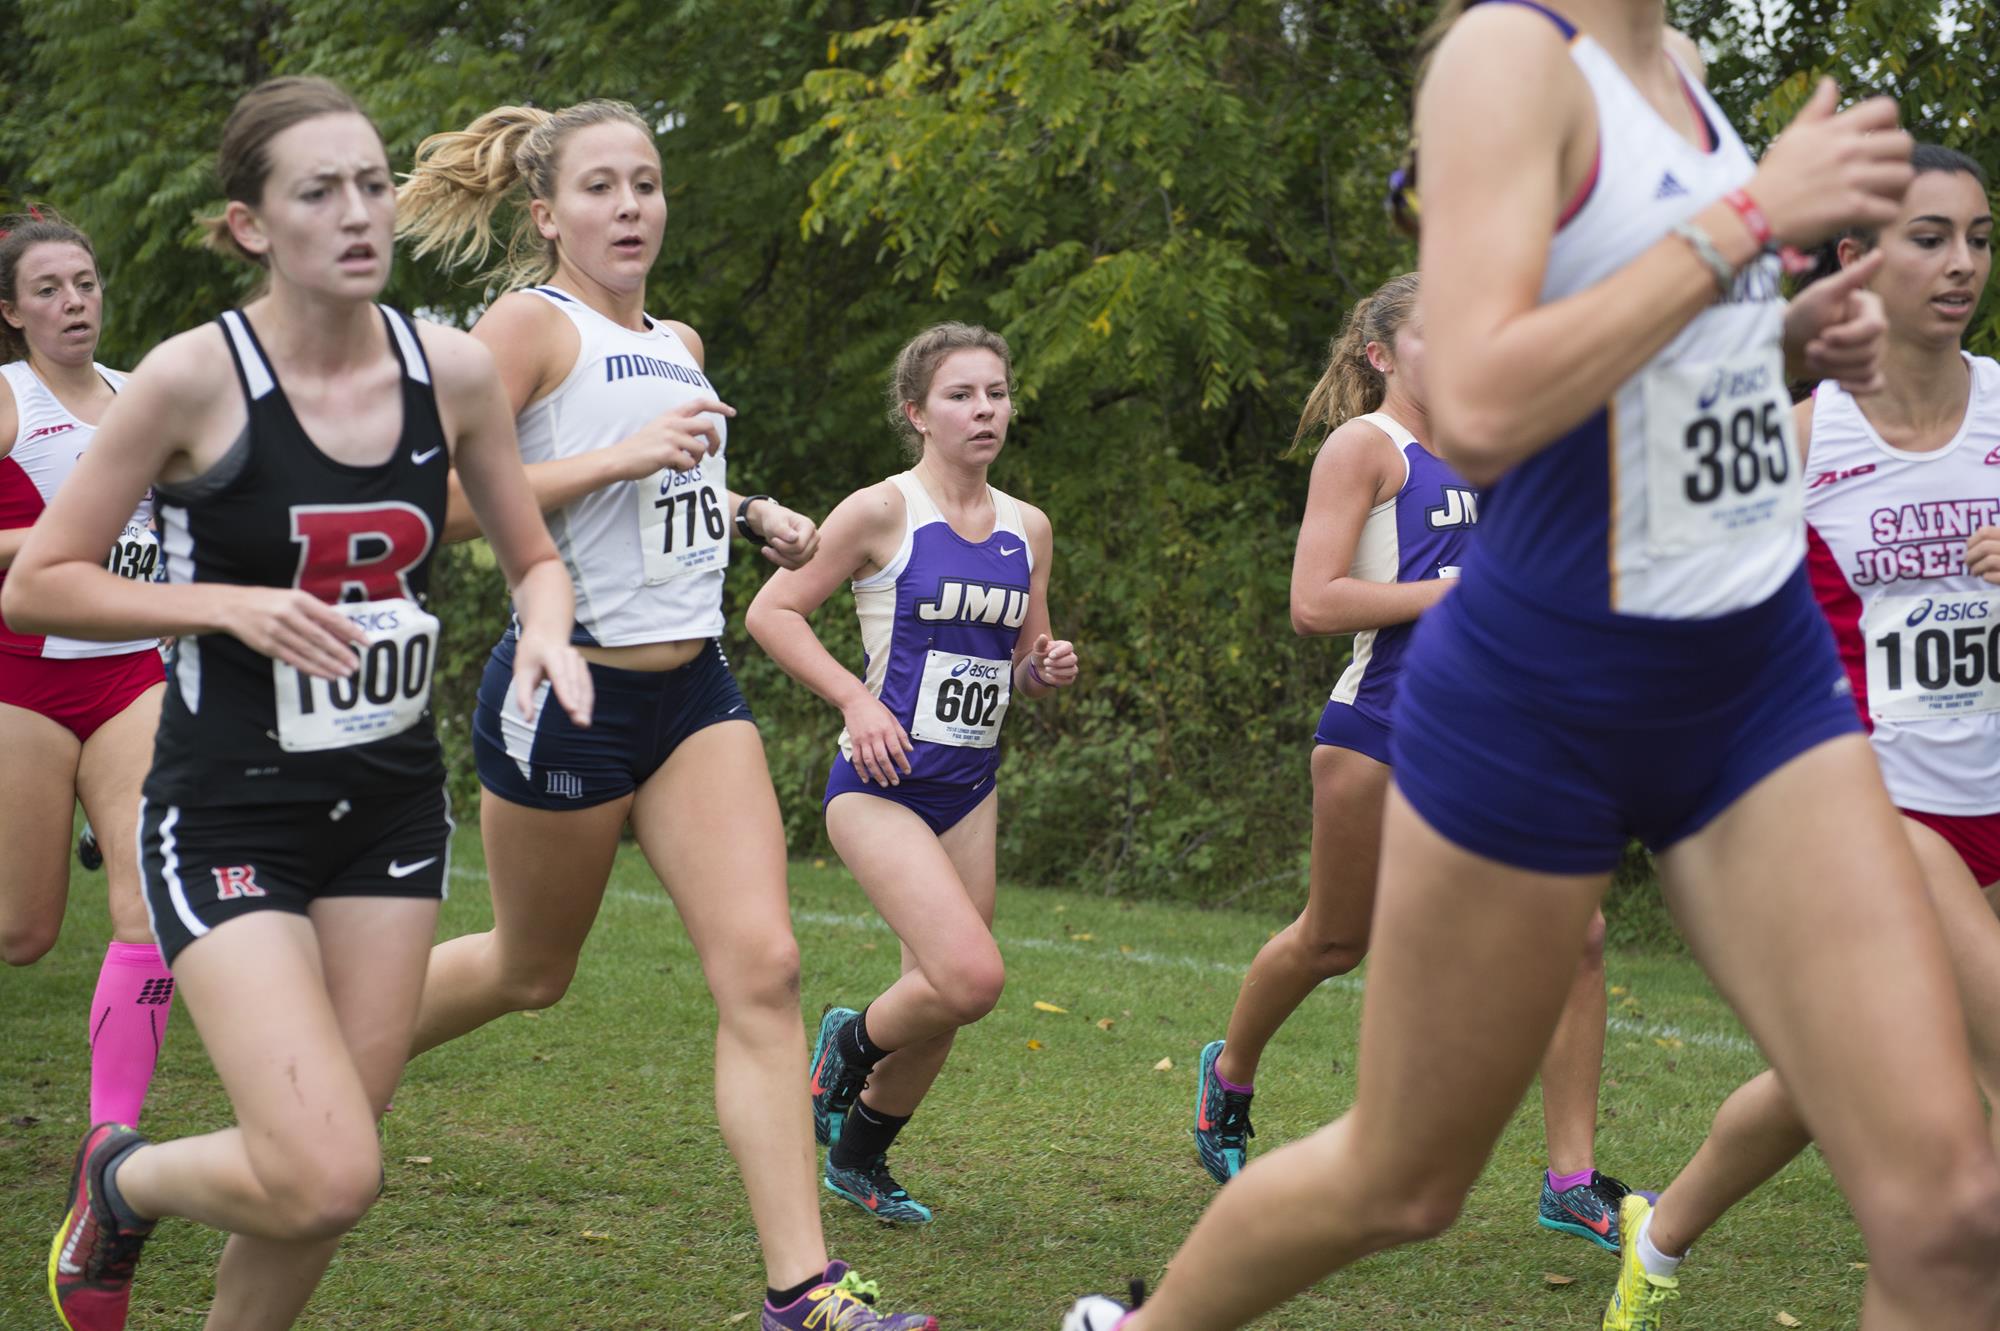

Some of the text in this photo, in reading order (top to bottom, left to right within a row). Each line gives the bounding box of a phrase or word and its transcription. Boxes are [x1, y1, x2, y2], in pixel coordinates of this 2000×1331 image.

[1684, 401, 1788, 504] 385
[655, 486, 726, 554] 776
[1870, 498, 2000, 545] SAINT
[104, 541, 157, 582] 034
[289, 500, 434, 606] R
[1853, 539, 1971, 586] JOSEP
[348, 611, 399, 631] sics
[916, 579, 1029, 631] JMU
[1935, 601, 1989, 621] asics
[969, 664, 999, 679] asics
[936, 678, 999, 727] 602
[211, 864, 267, 900] R
